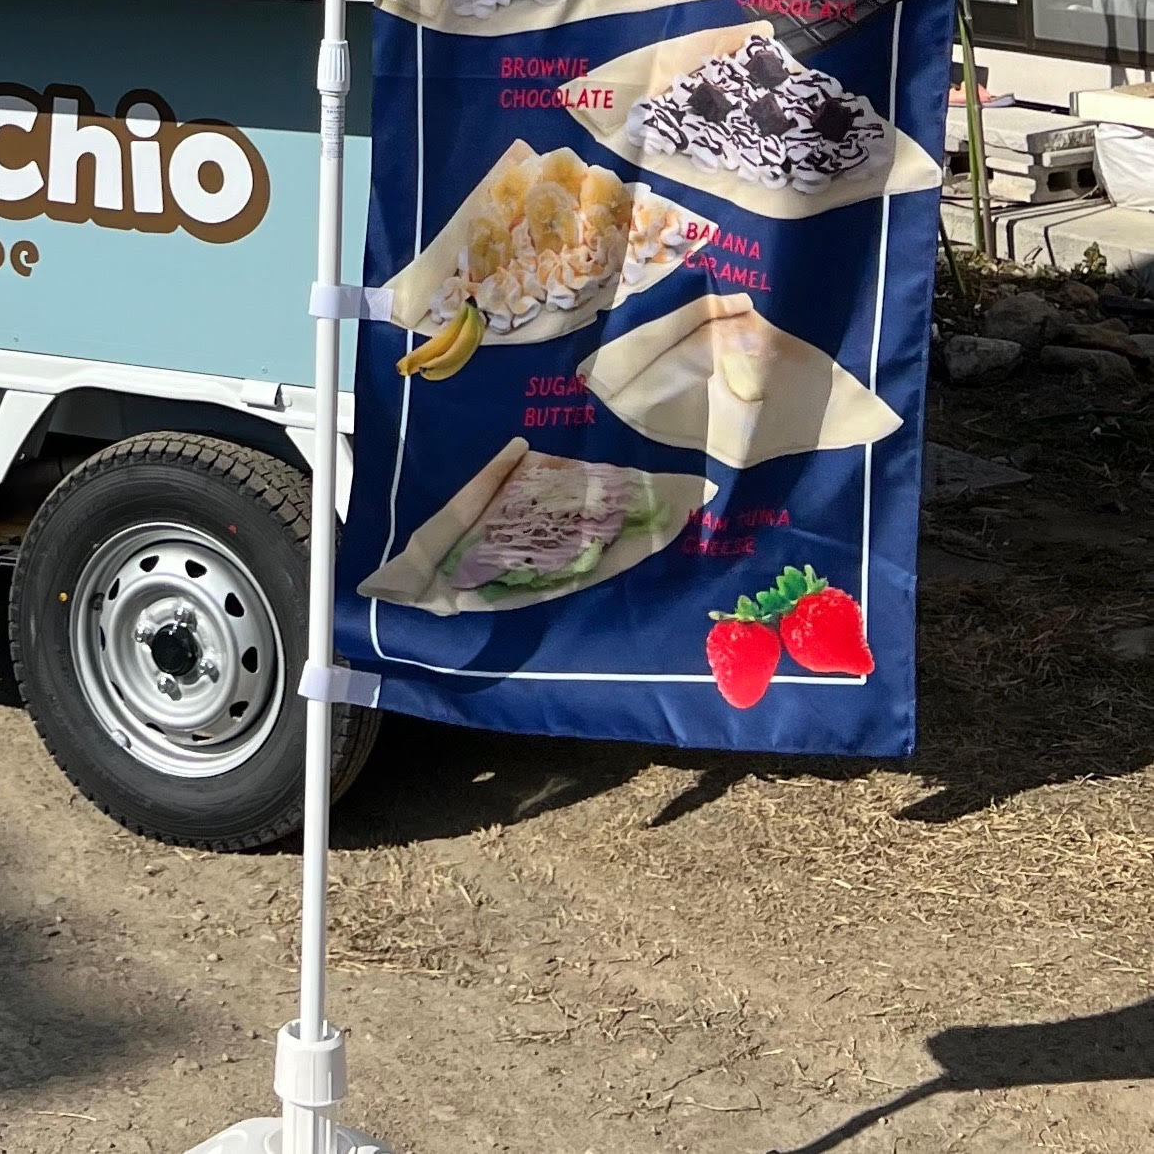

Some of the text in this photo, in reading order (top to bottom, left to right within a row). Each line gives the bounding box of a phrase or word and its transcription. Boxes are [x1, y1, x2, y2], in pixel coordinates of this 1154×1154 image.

[501, 56, 590, 79] BROWNIE
[500, 88, 614, 109] CHOCOLATE
[687, 222, 761, 260] BANANA
[685, 250, 772, 293] CARAMEL
[526, 374, 591, 397] SUGAR
[524, 404, 596, 427] BUTTER
